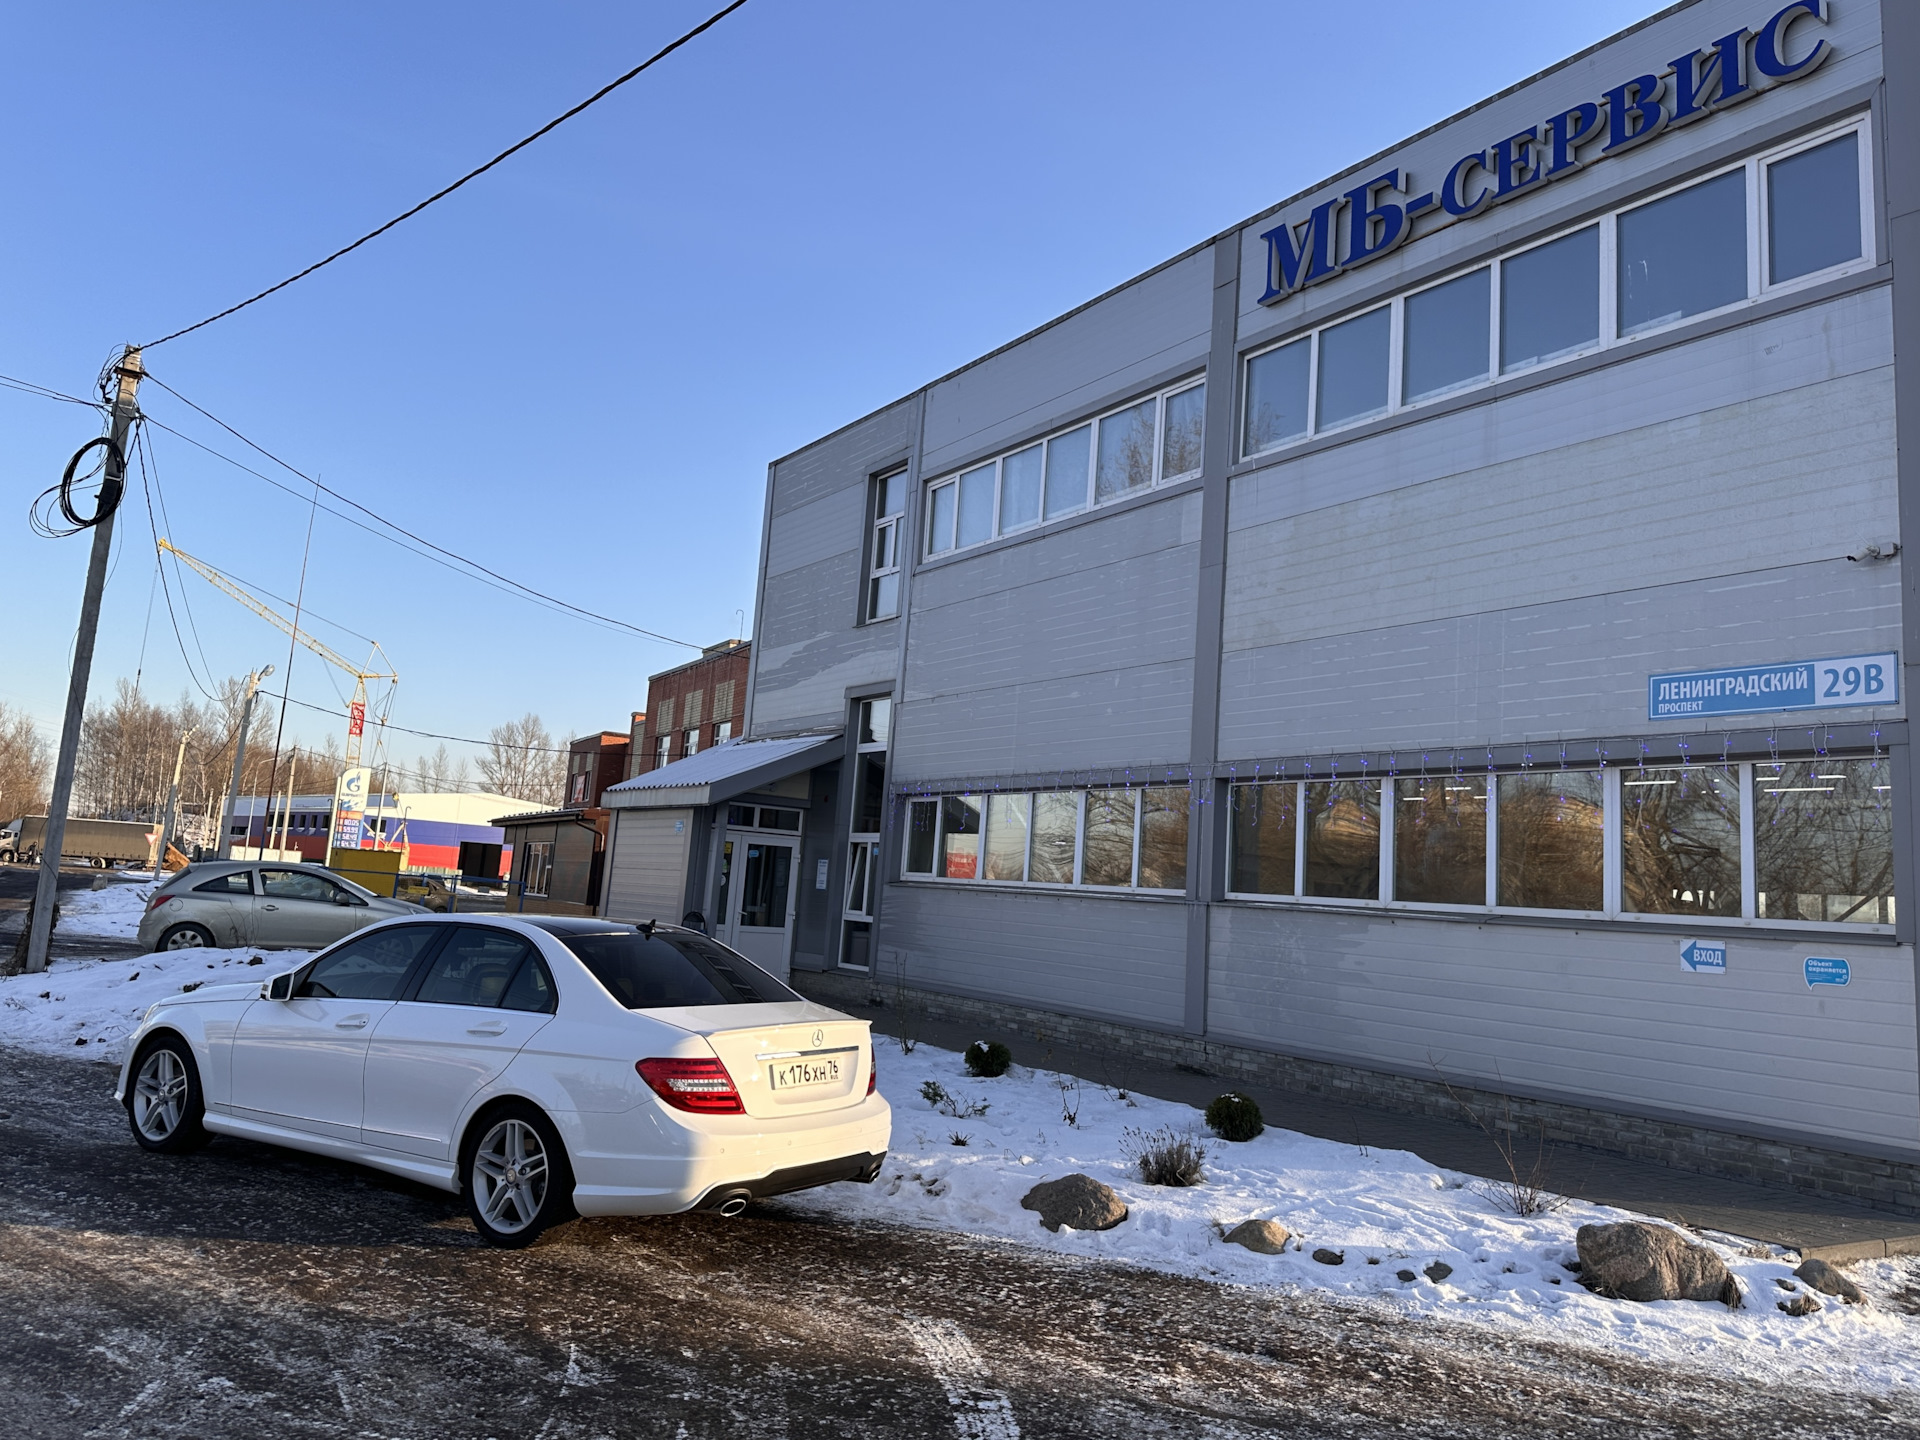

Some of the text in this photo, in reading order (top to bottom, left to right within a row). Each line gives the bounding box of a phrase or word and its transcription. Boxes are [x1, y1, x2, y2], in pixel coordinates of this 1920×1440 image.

[1257, 0, 1832, 307] МБ-СЕРВИС
[1658, 663, 1885, 701] ЛЕНИНГРАДСКИЙ 29В
[1658, 700, 1704, 714] ПРОСПЕКТ
[1693, 948, 1722, 966] ВХОД
[1808, 959, 1833, 968] Объект
[1808, 966, 1847, 975] охраняется
